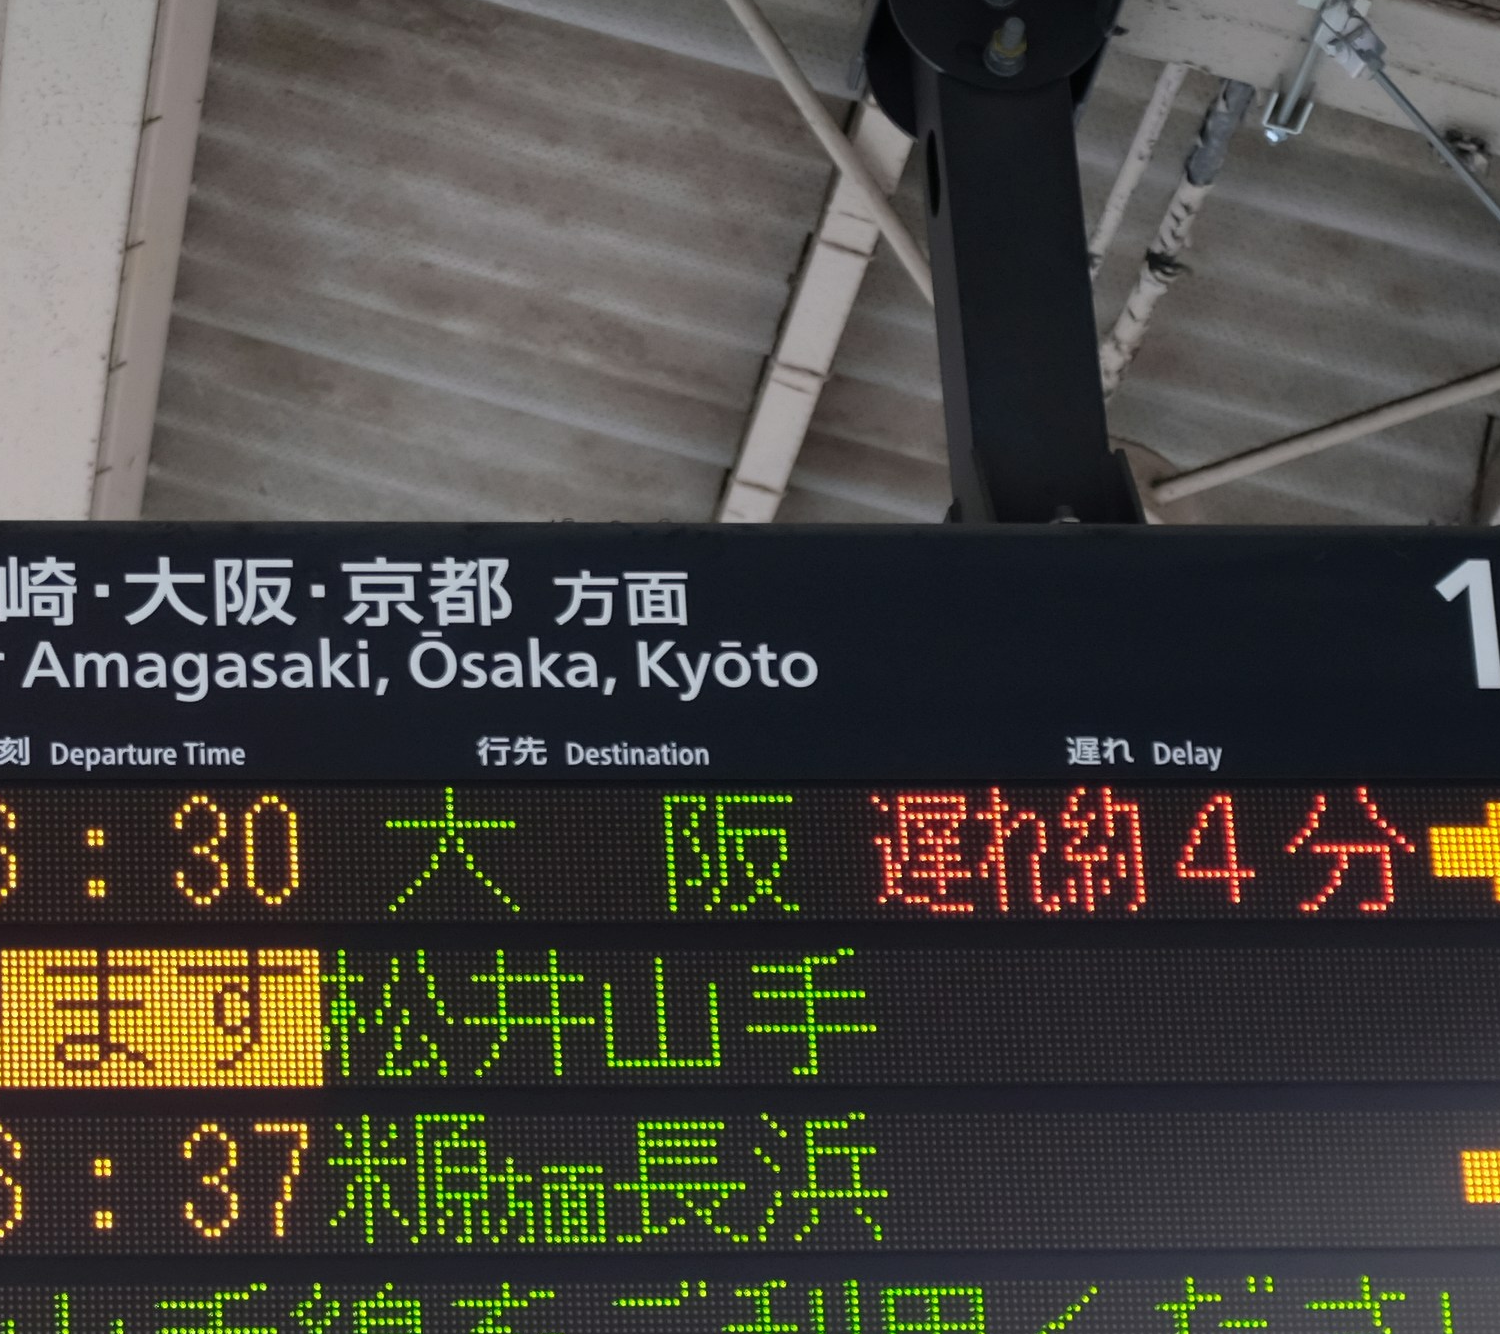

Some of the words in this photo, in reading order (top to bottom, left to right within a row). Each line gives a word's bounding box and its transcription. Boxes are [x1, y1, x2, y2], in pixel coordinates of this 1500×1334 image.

[553, 569, 689, 626] 方面
[21, 637, 390, 703] Amagasaki,
[409, 631, 617, 696] Ōsaka,
[637, 640, 819, 702] Kyōto
[50, 742, 178, 772] Departure
[182, 741, 246, 766] Time
[476, 736, 548, 766] 行先
[565, 742, 710, 766] Destination
[1066, 737, 1135, 765] 遅れ
[1153, 740, 1223, 772] Delay
[321, 948, 877, 1086] 松井山手
